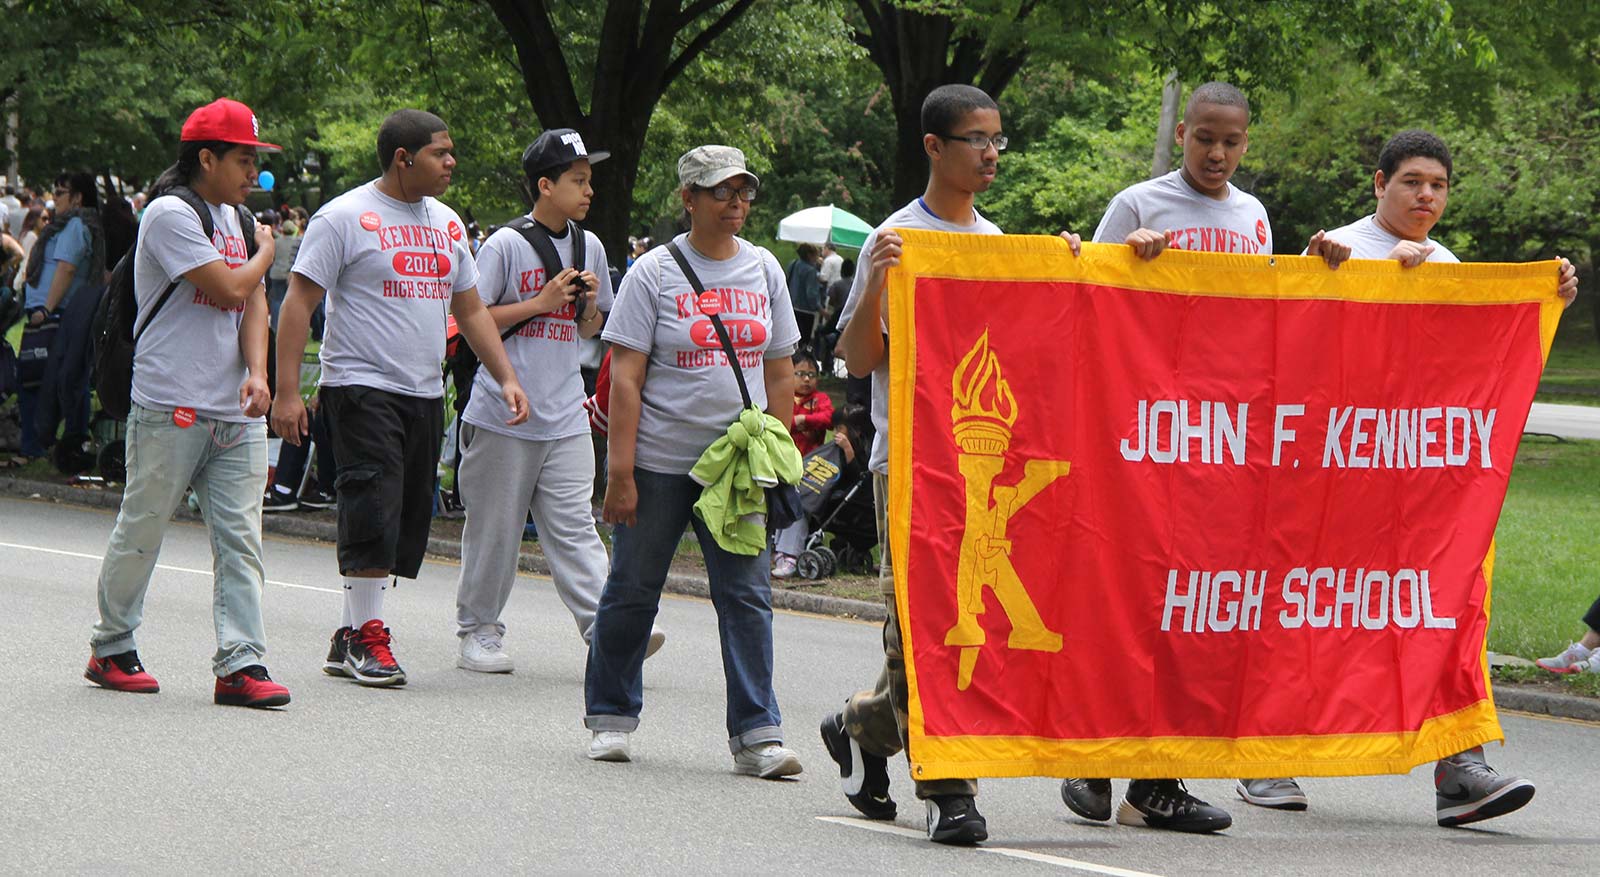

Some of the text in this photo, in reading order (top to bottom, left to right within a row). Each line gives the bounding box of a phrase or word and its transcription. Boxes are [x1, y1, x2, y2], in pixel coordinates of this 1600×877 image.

[377, 225, 454, 254] KENNEDY
[404, 256, 440, 274] 2014
[383, 280, 416, 298] HIGH
[417, 281, 451, 299] SCHOO
[675, 288, 767, 320] KENEDY
[705, 324, 753, 343] 214
[677, 349, 715, 369] HIGH
[1120, 400, 1497, 468] JOHN F. KENNEDY
[1161, 567, 1456, 632] HIGH SCHOOL
